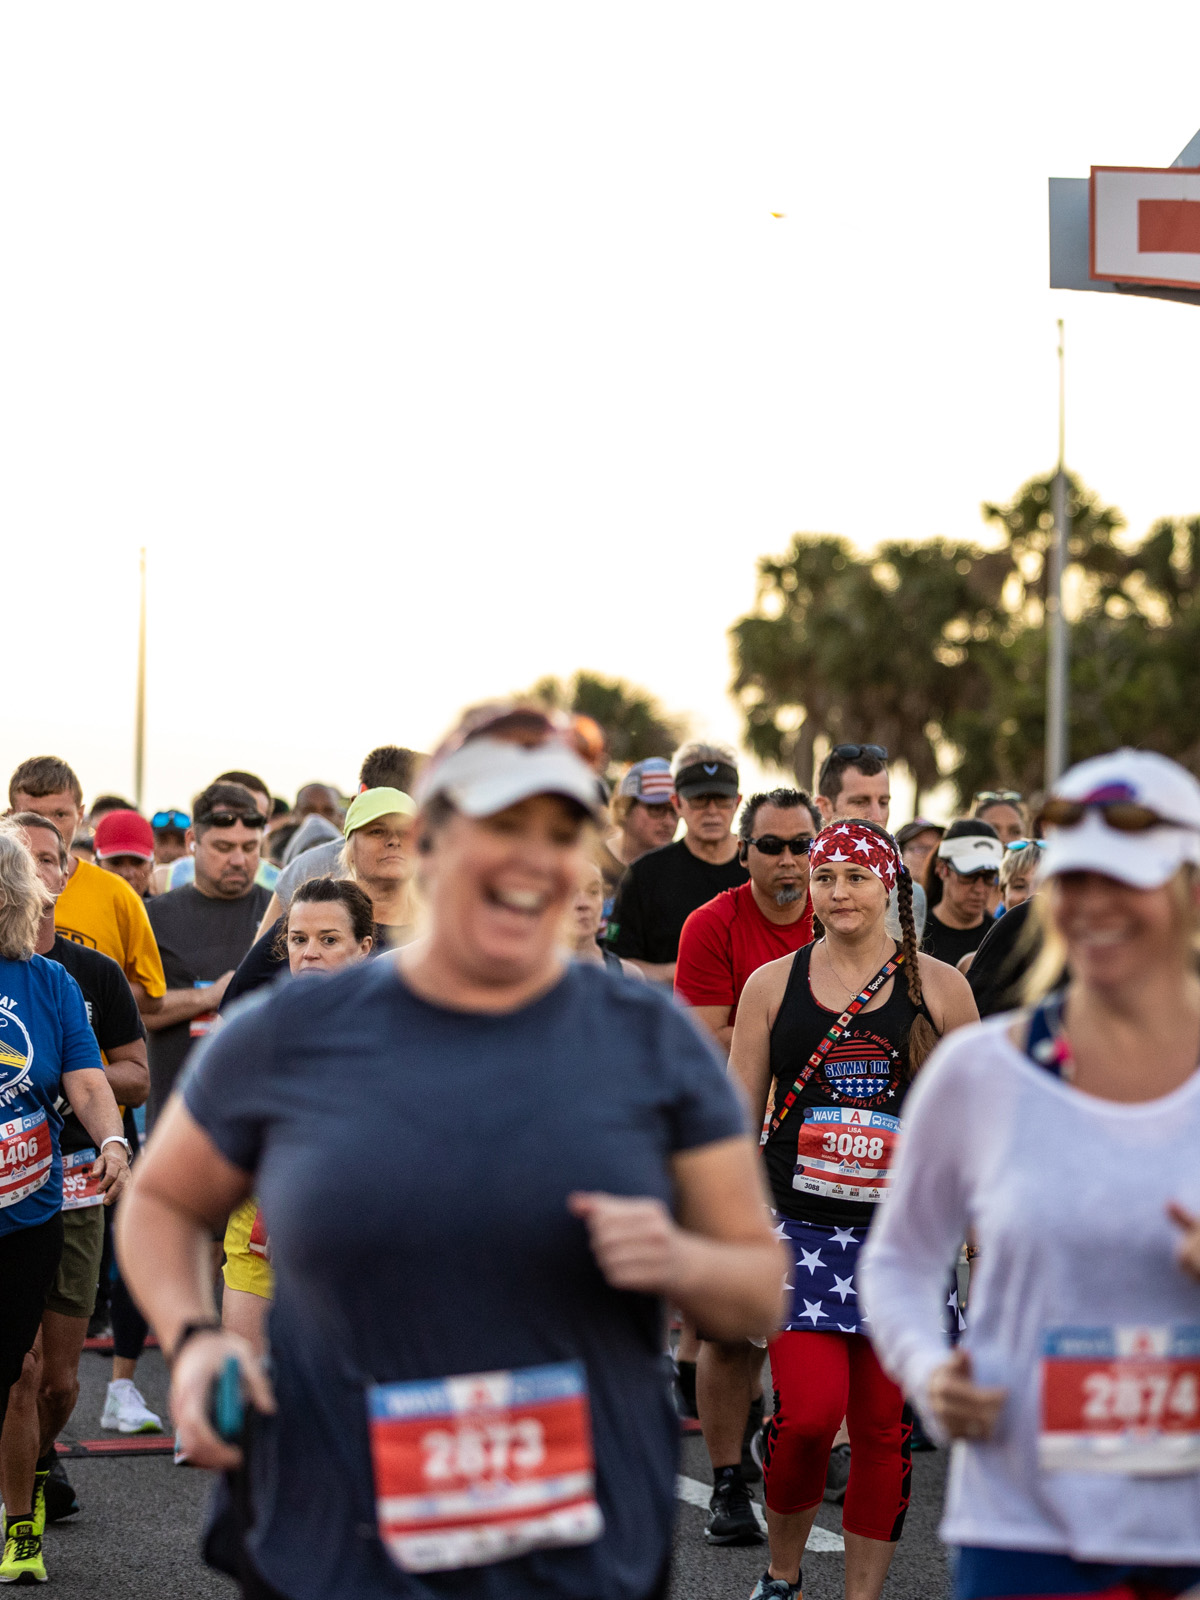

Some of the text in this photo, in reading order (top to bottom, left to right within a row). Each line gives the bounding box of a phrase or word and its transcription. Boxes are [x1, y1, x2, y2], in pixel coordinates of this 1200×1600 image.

[868, 976, 885, 991] Epcot
[854, 1030, 893, 1051] 6.2 miles
[824, 1061, 868, 1078] SKYWAY
[870, 1060, 890, 1074] 10K
[813, 1111, 840, 1121] WAVE
[850, 1111, 861, 1124] A
[6, 1123, 16, 1136] B
[847, 1126, 862, 1134] LISA
[822, 1132, 884, 1160] 3088
[63, 1173, 87, 1193] 95
[804, 1183, 820, 1192] 3088
[1082, 1371, 1199, 1420] 2874
[421, 1416, 545, 1480] 2873
